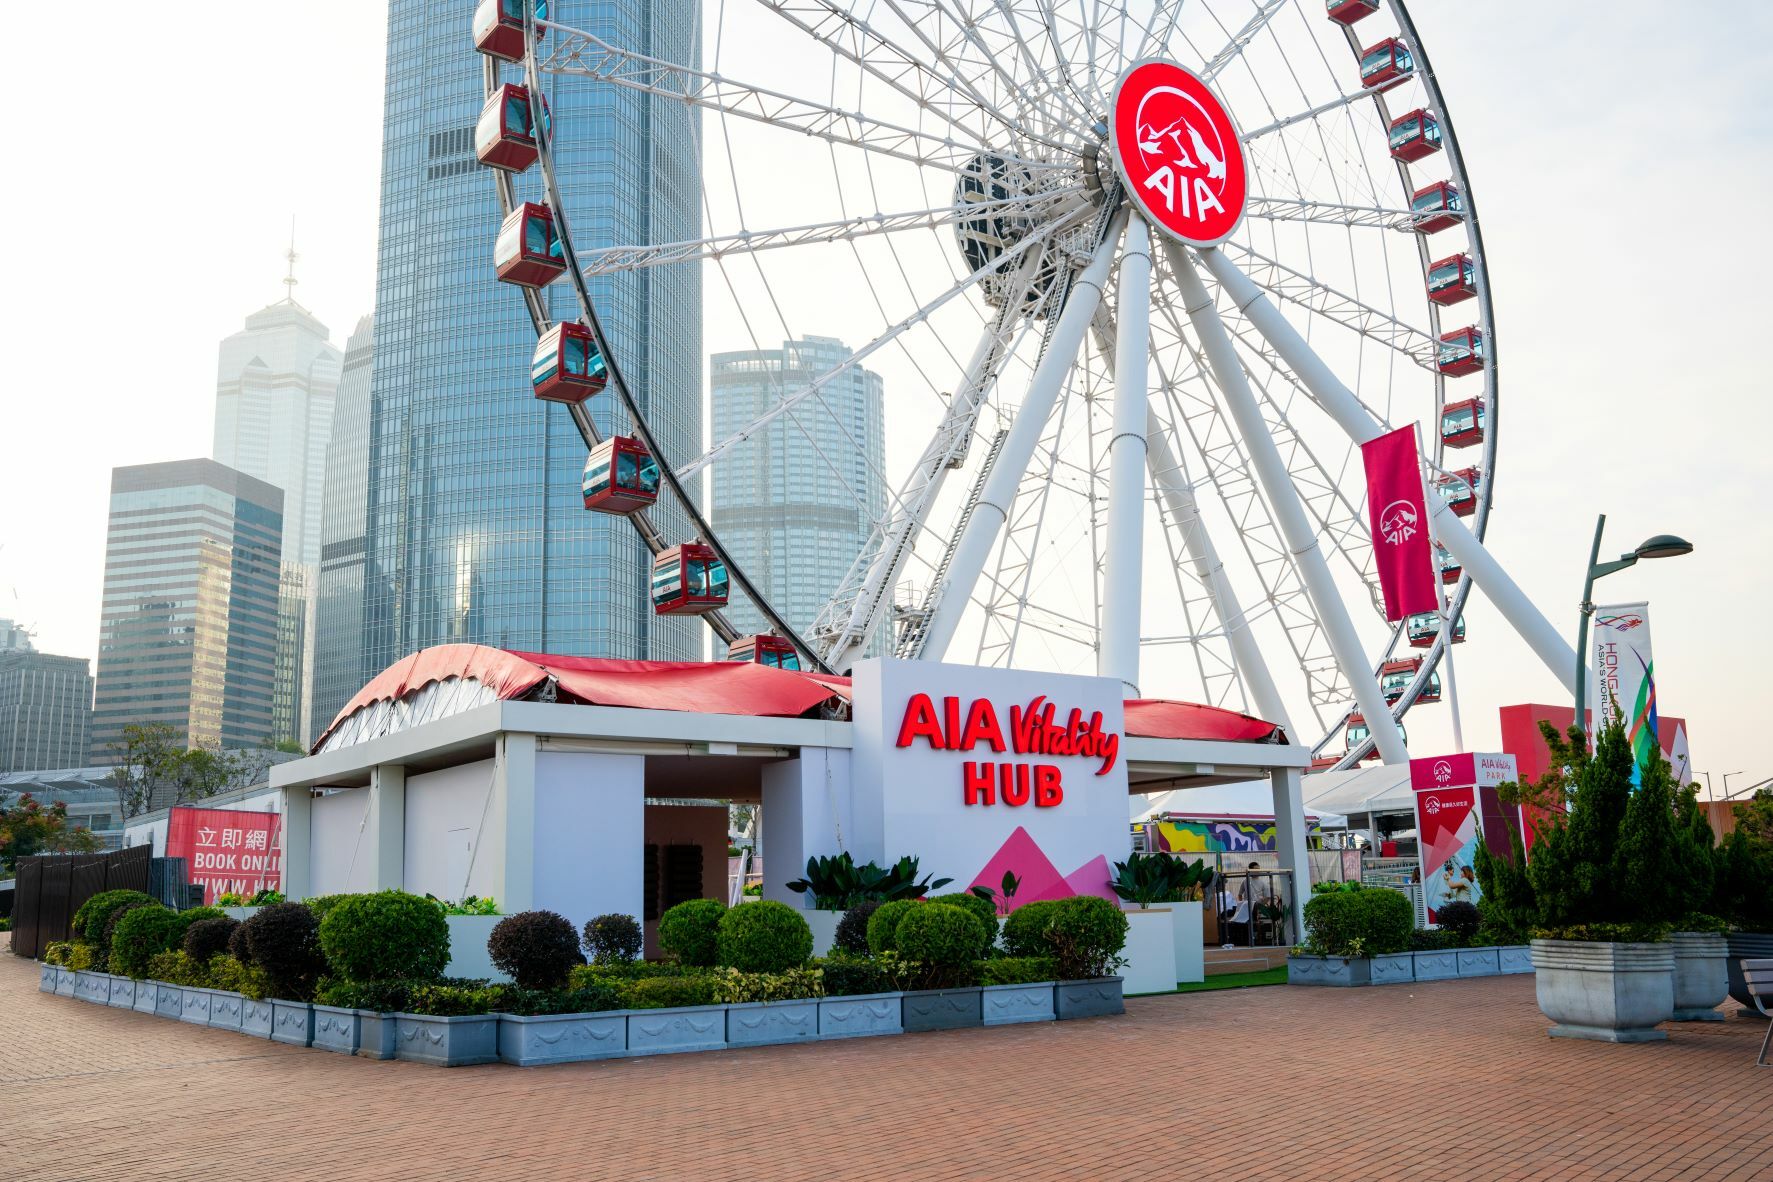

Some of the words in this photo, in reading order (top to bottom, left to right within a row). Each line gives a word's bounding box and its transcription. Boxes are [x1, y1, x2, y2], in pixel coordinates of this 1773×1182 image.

[1143, 165, 1225, 223] AIA
[1385, 525, 1416, 546] AIA
[1598, 644, 1606, 676] ASIA'S
[1605, 642, 1619, 690] HONG
[1600, 678, 1609, 714] WORLD
[895, 693, 1007, 752] AIA
[1009, 695, 1119, 776] Vitality
[1482, 759, 1495, 769] AIA
[1486, 771, 1505, 780] PARK
[963, 761, 1064, 807] HUB
[1435, 774, 1451, 782] AIA
[1426, 807, 1440, 815] AIA
[194, 852, 237, 870] BOOK
[241, 855, 281, 872] ONLI
